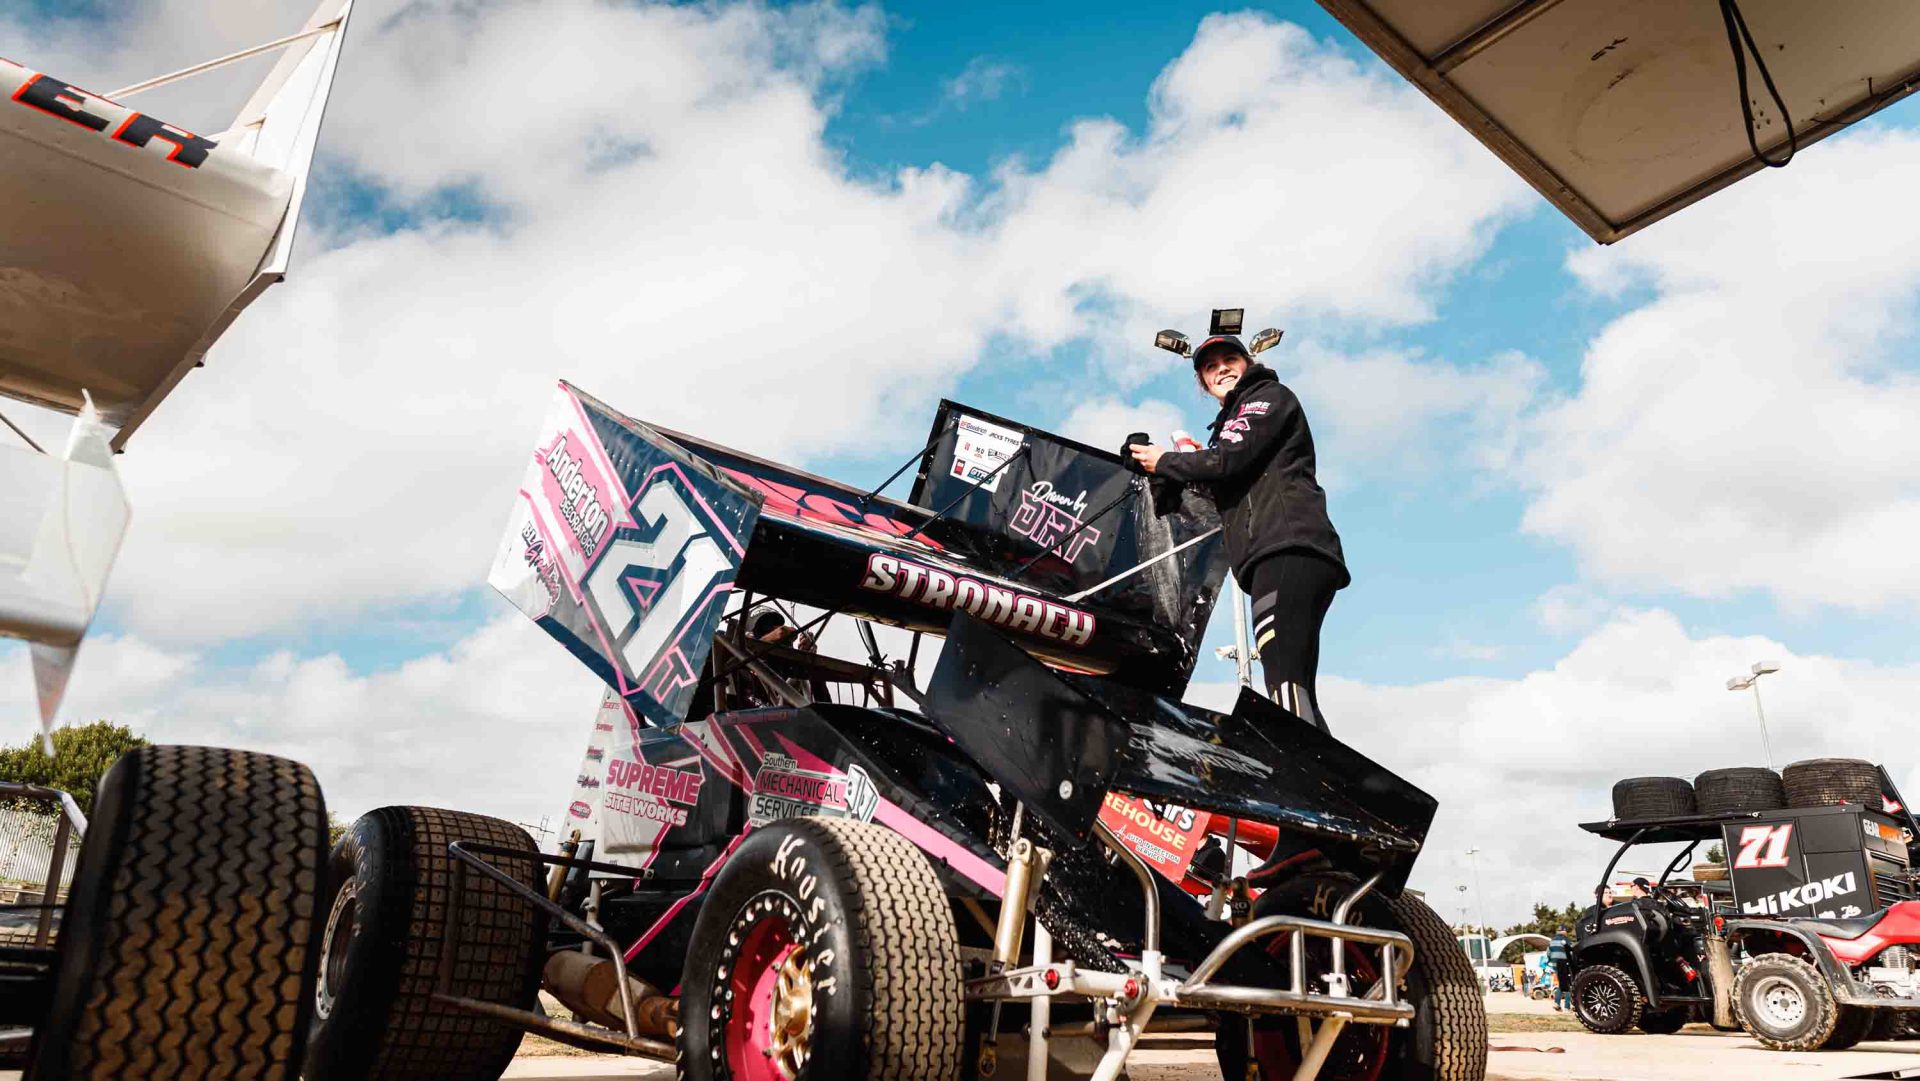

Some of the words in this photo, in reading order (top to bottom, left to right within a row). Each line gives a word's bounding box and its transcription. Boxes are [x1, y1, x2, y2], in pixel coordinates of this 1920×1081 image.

[546, 436, 610, 545] Anderton
[1031, 480, 1075, 506] Driven
[1071, 490, 1089, 519] by
[559, 496, 596, 559] DECORATORS
[1009, 489, 1101, 564] DIRT
[860, 553, 1096, 646] STRONACH
[764, 752, 798, 769] Southern
[606, 759, 701, 806] SUPREME
[761, 771, 840, 804] MECHANICAL
[604, 792, 632, 814] SITE
[633, 797, 689, 827] WORKS
[1126, 833, 1143, 845] AUTO
[1143, 839, 1180, 864] INSPECTION
[1136, 845, 1166, 864] SERVICES
[1735, 823, 1793, 869] 71
